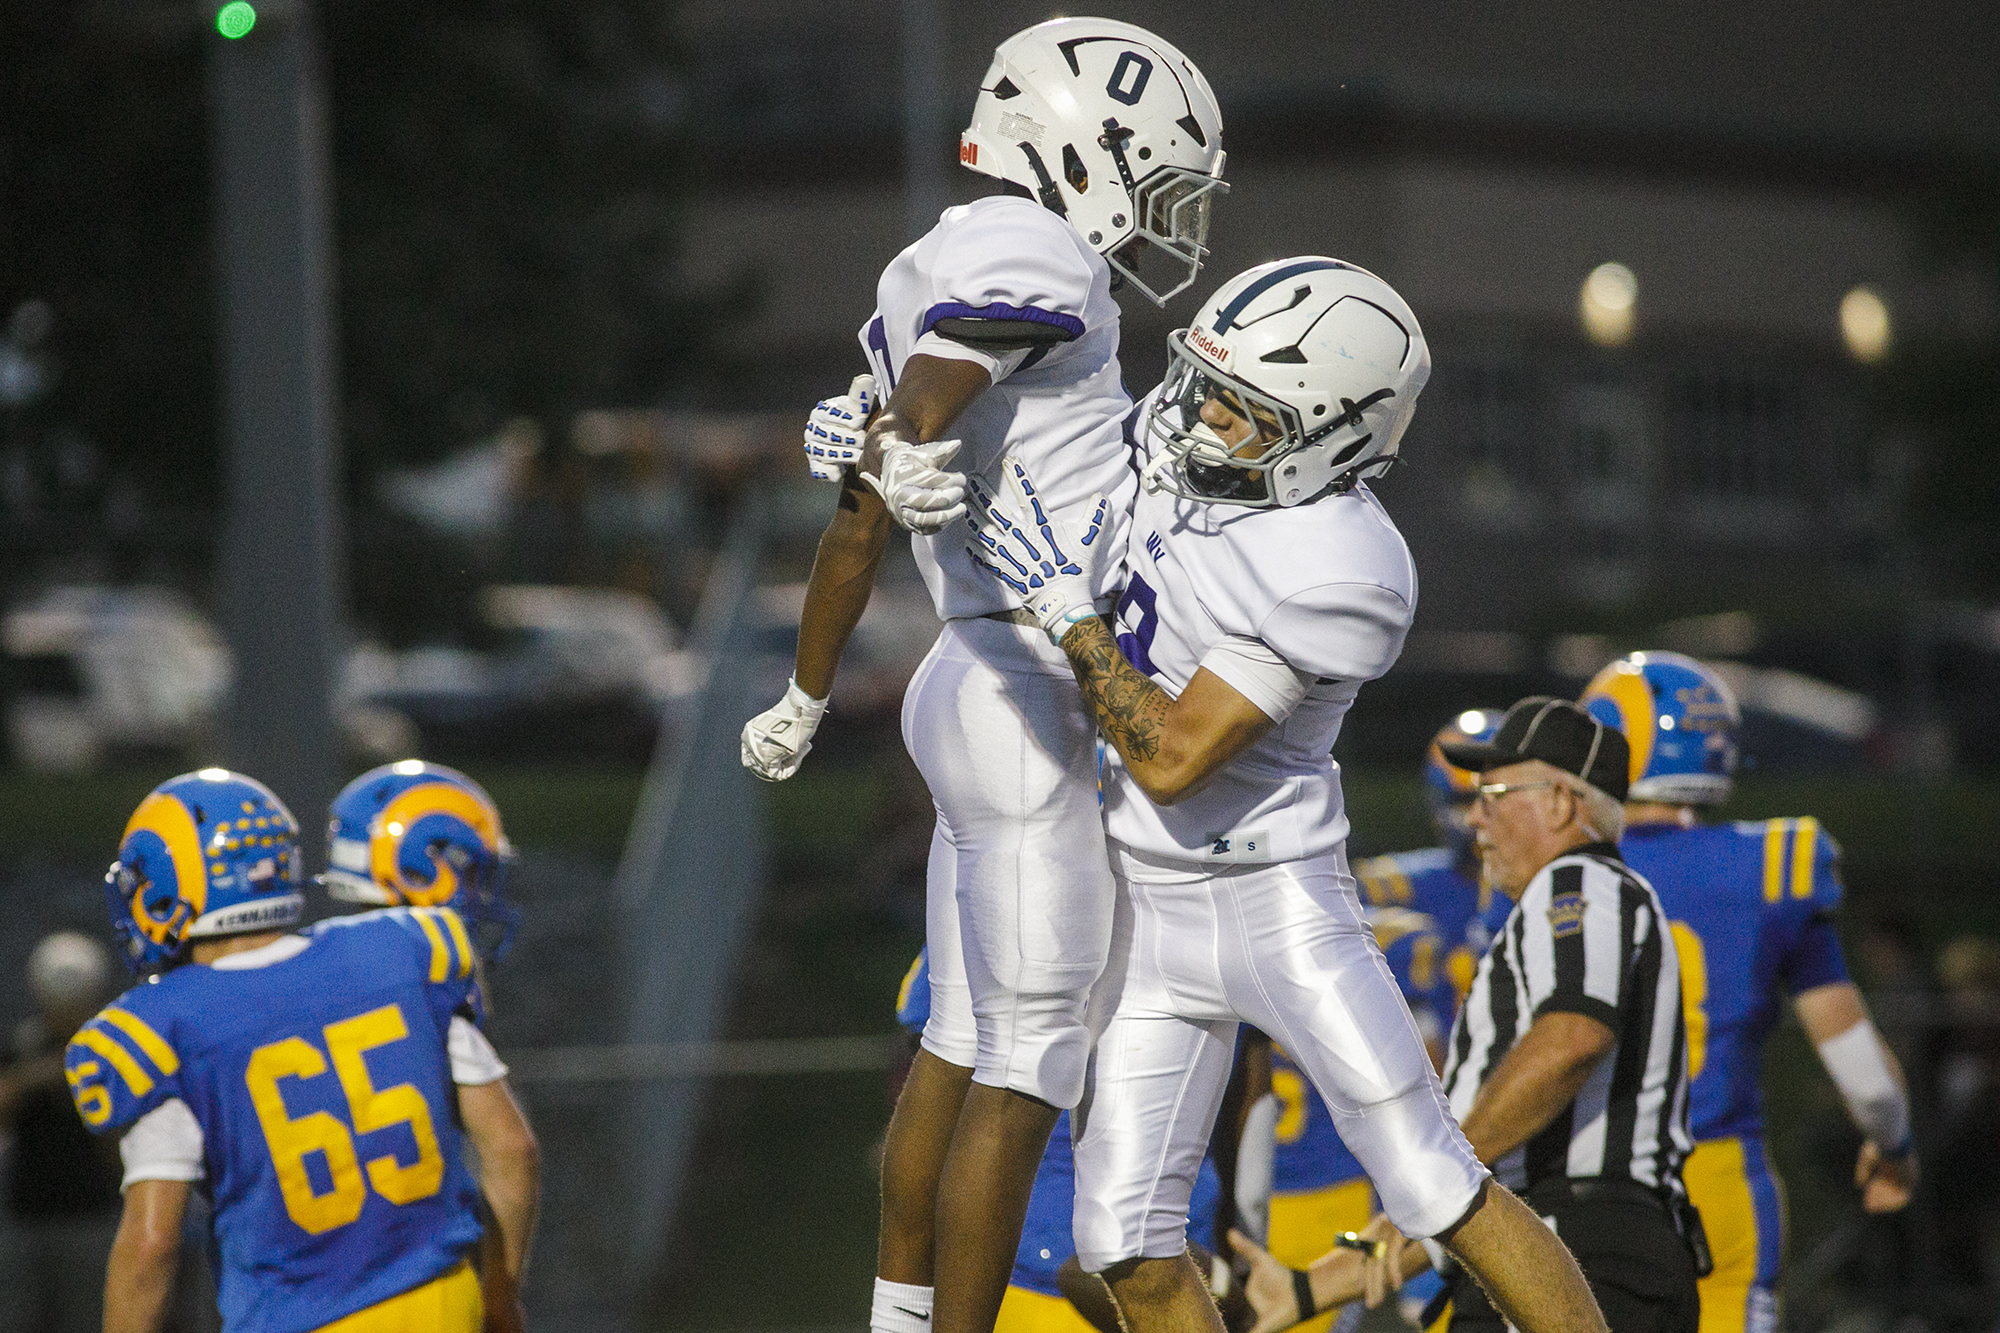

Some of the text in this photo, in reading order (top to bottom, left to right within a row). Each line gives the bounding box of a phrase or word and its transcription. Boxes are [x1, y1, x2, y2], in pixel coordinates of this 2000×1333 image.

[1190, 327, 1229, 362] Riddell
[1247, 841, 1256, 852] S
[246, 1004, 445, 1235] 65
